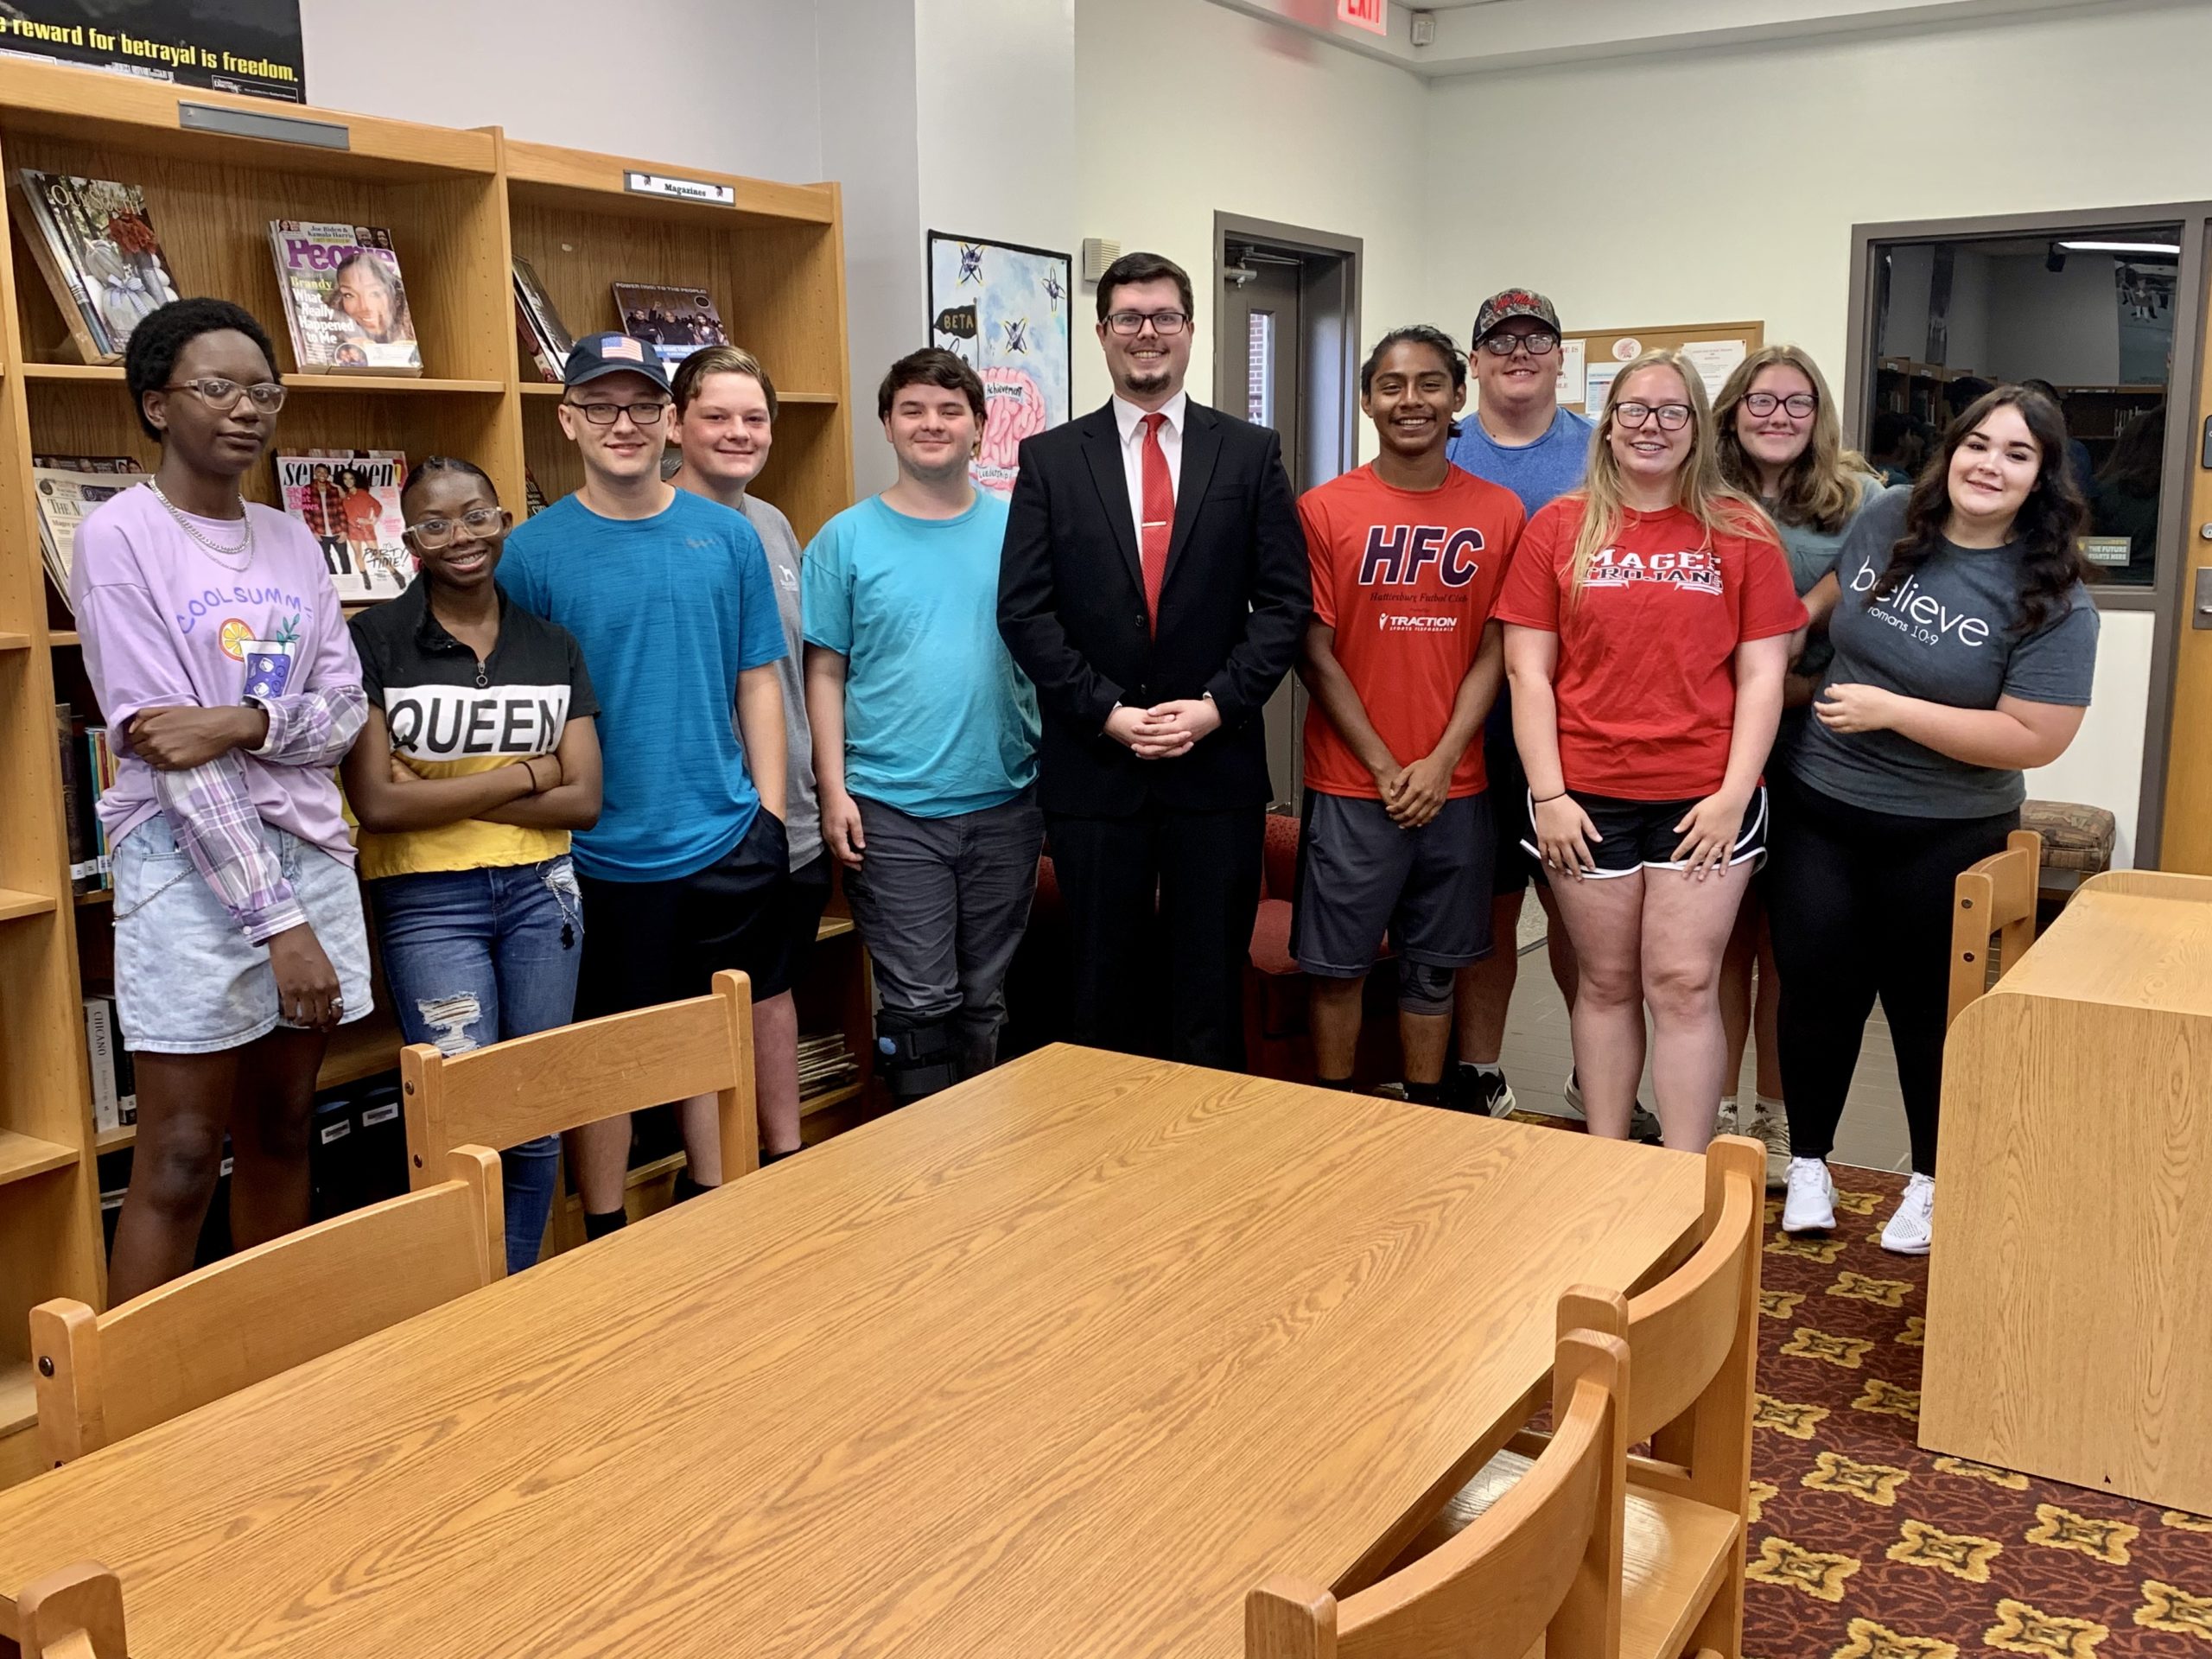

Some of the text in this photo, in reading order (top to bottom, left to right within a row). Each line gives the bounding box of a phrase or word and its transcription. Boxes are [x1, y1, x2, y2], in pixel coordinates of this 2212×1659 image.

[12, 19, 83, 46] reward
[89, 28, 116, 51] for
[121, 33, 196, 67] betrayal
[200, 48, 218, 69] is
[222, 51, 299, 82] freedom.
[664, 182, 707, 197] Magazines
[290, 276, 333, 289] Brandy
[292, 288, 322, 302] What
[301, 302, 335, 320] Really
[298, 315, 356, 333] Happened
[944, 314, 974, 330] BETA
[306, 331, 338, 344] to Me
[1357, 524, 1484, 588] HFC
[1420, 593, 1446, 602] Futbol
[1389, 616, 1458, 626] TRACTION
[1867, 607, 1939, 646] romans 10:9
[388, 697, 563, 754] QUEEN
[93, 1011, 107, 1057] CHICANO
